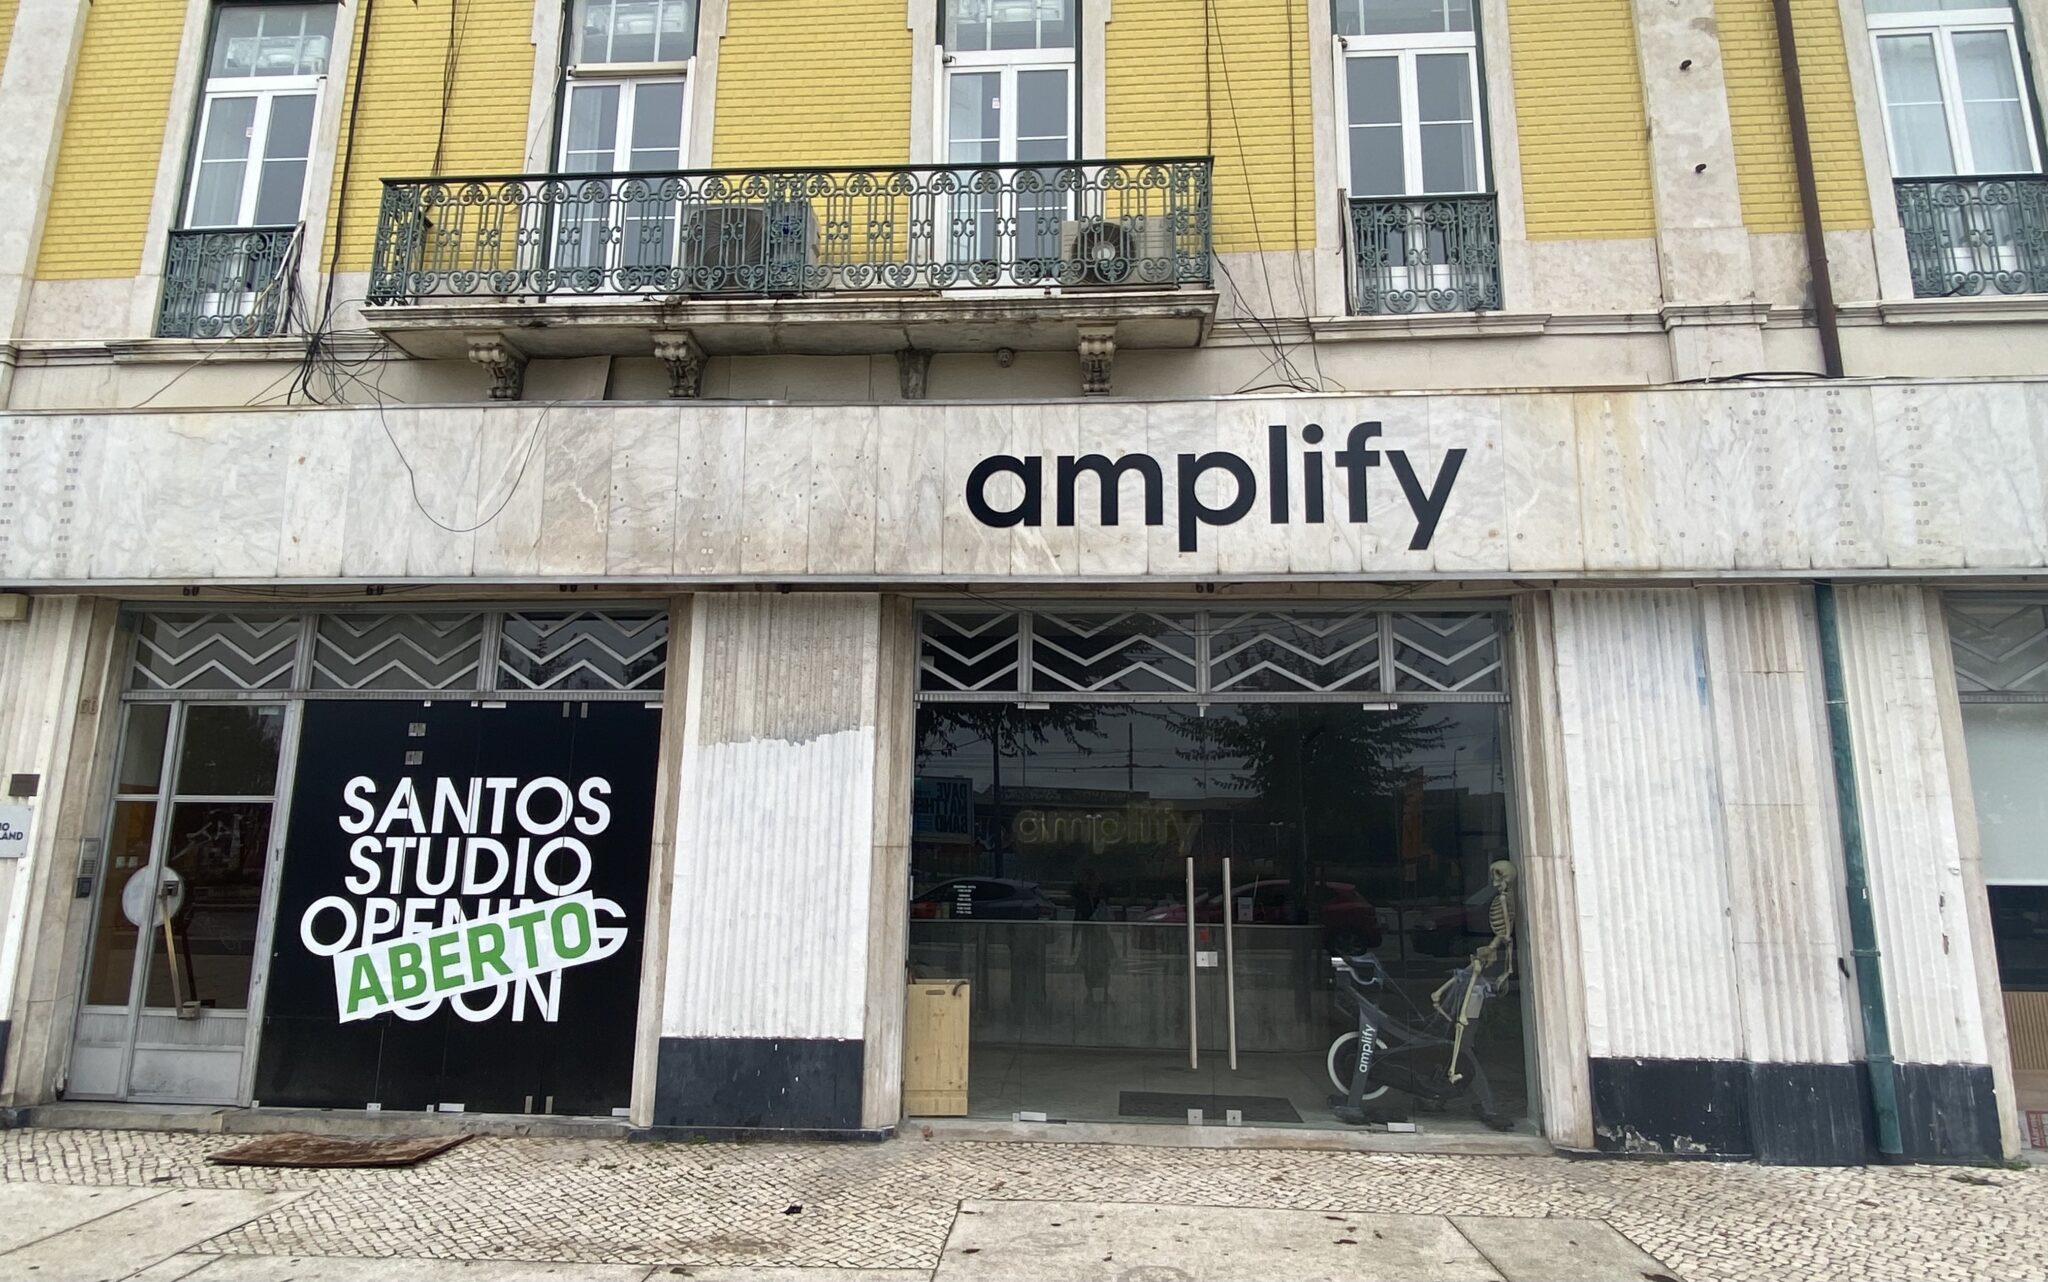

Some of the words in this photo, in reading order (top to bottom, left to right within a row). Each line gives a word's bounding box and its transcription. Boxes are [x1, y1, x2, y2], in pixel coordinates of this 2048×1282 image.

[965, 421, 1467, 552] amplify
[338, 775, 612, 836] SANTOS
[1013, 800, 1202, 855] amplify
[344, 836, 593, 896] STUDIO
[346, 901, 592, 1014] ABERTO
[1359, 1023, 1376, 1073] amplify
